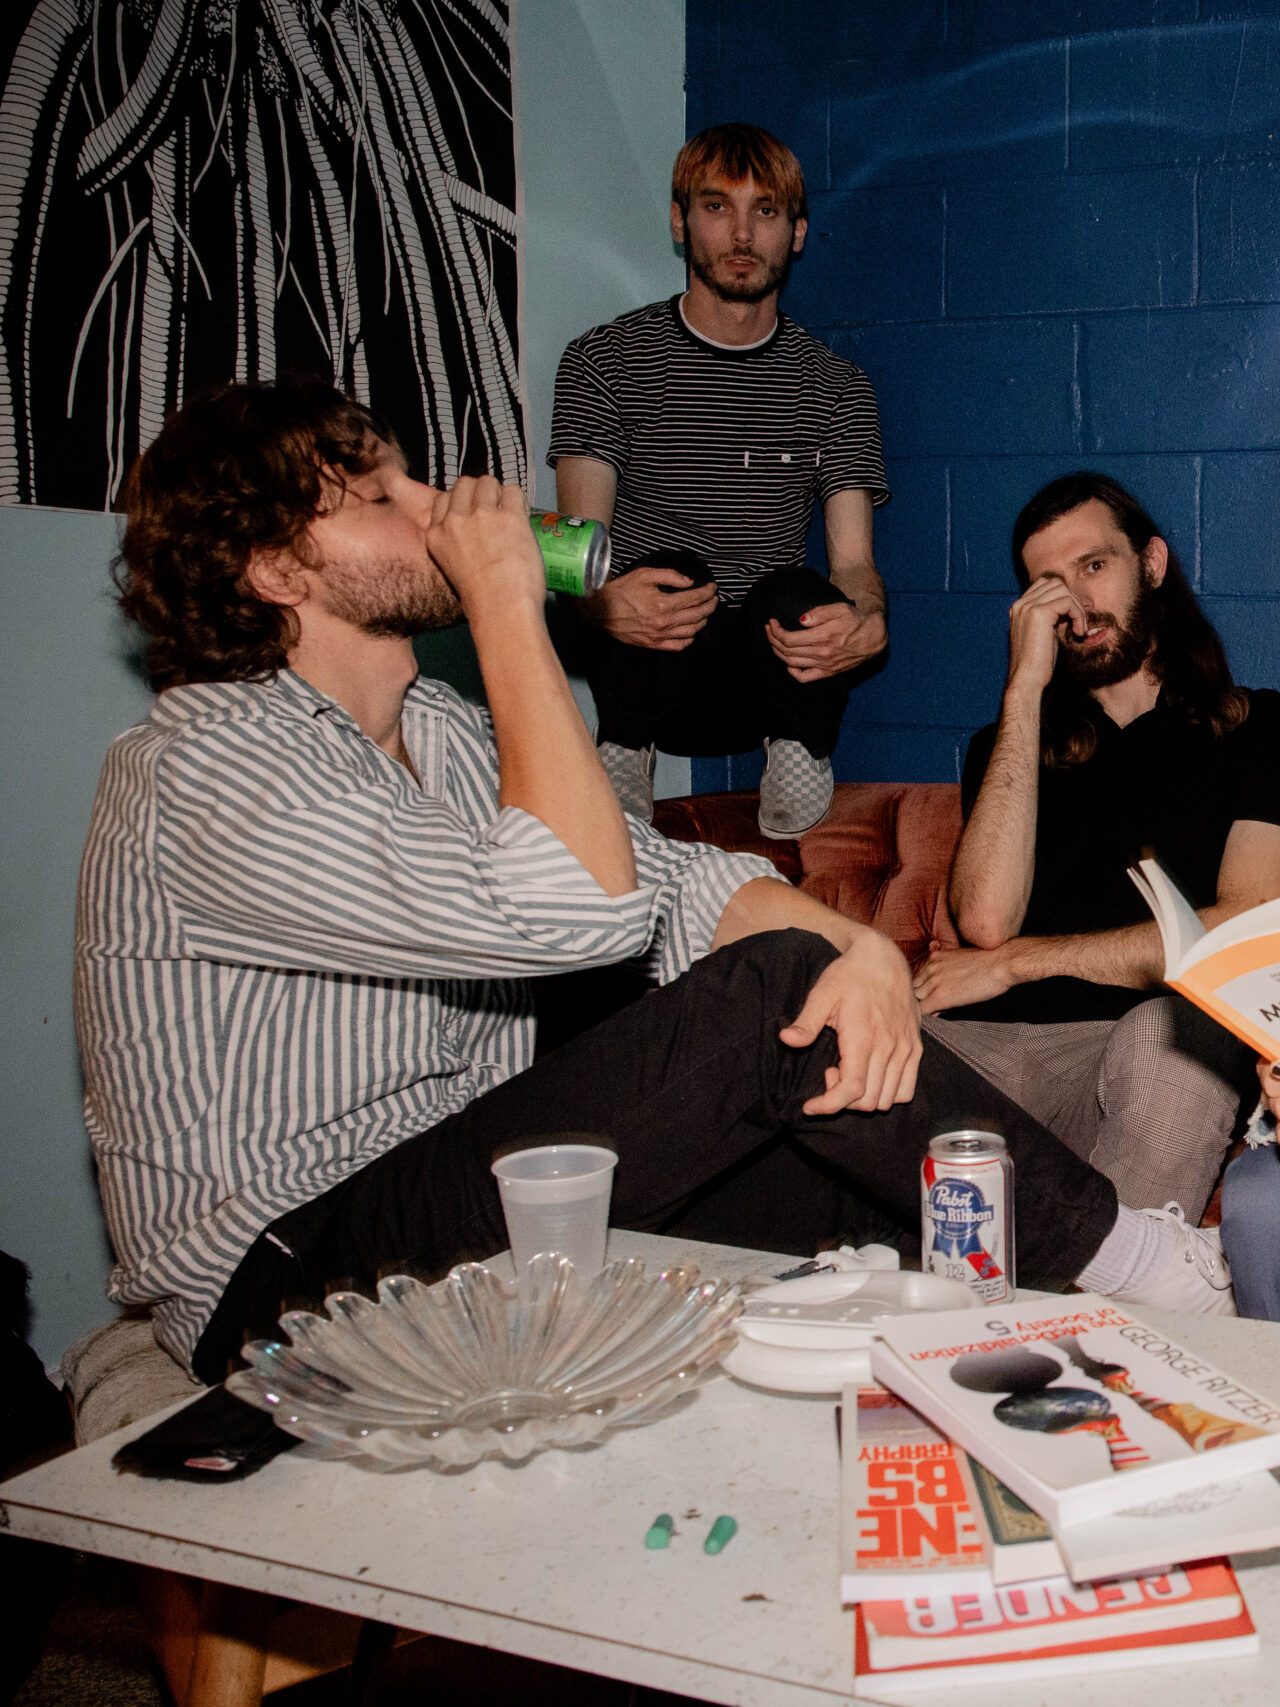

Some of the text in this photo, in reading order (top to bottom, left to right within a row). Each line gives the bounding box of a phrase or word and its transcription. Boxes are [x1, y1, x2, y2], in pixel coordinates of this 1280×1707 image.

[934, 1184, 975, 1208] Pabst
[946, 1205, 994, 1224] Ribbon
[945, 1262, 966, 1279] 12
[984, 1307, 1117, 1337] of Society 5
[908, 1315, 1135, 1362] The McDonaldization
[1119, 1325, 1211, 1380] GEORGE
